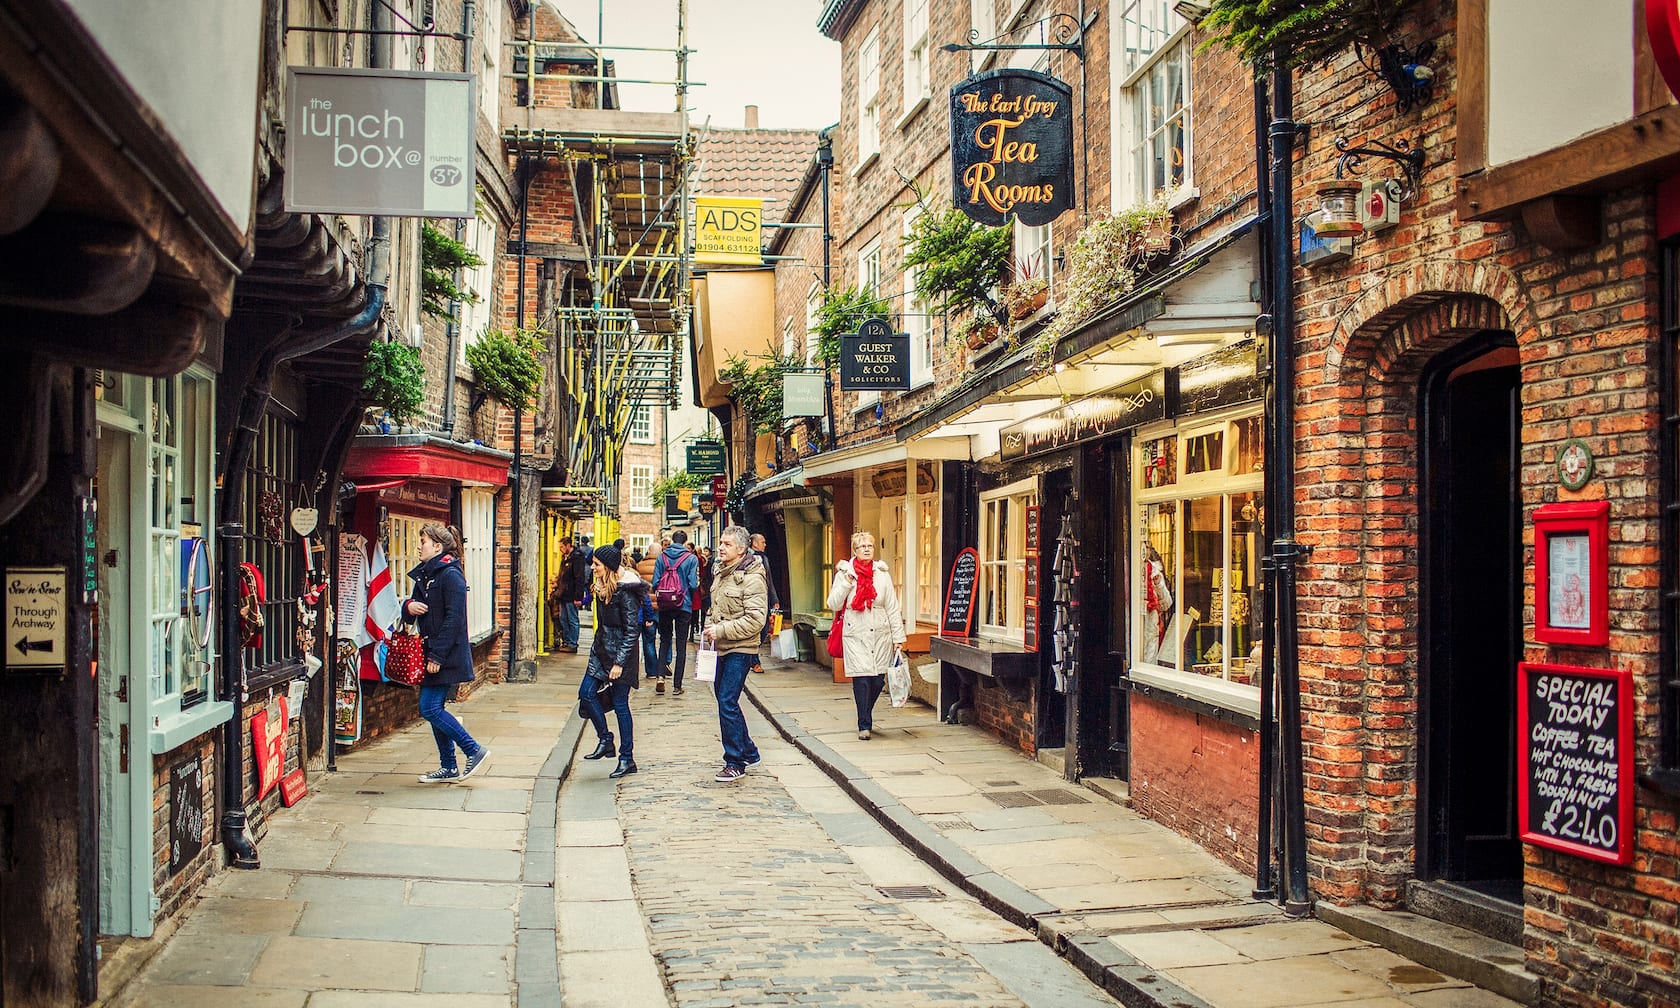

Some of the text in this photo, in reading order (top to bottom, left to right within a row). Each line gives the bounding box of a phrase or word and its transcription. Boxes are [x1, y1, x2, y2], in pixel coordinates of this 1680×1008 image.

[310, 98, 332, 110] the
[961, 91, 1058, 119] The Earl Grey
[302, 106, 404, 139] lunch
[975, 115, 1039, 164] Tea
[430, 155, 462, 163] number
[433, 168, 459, 185] 37
[963, 162, 1054, 213] Rooms
[702, 210, 757, 232] ADS
[697, 243, 759, 253] 01904 631124
[704, 234, 753, 243] SCAFFOLDING
[855, 354, 897, 364] WALKER
[858, 344, 893, 353] GUEST
[862, 366, 890, 374] & CO
[12, 617, 56, 631] Archway
[13, 606, 58, 620] Through
[1536, 675, 1615, 708] SPECIAL
[1547, 701, 1609, 731] TODAY
[1532, 722, 1615, 760] COFFEE TEA
[1531, 746, 1619, 780] HOT CHOCOLATE
[1534, 766, 1618, 797] WITH A FRESH
[1537, 781, 1611, 811] DOUGHNUT
